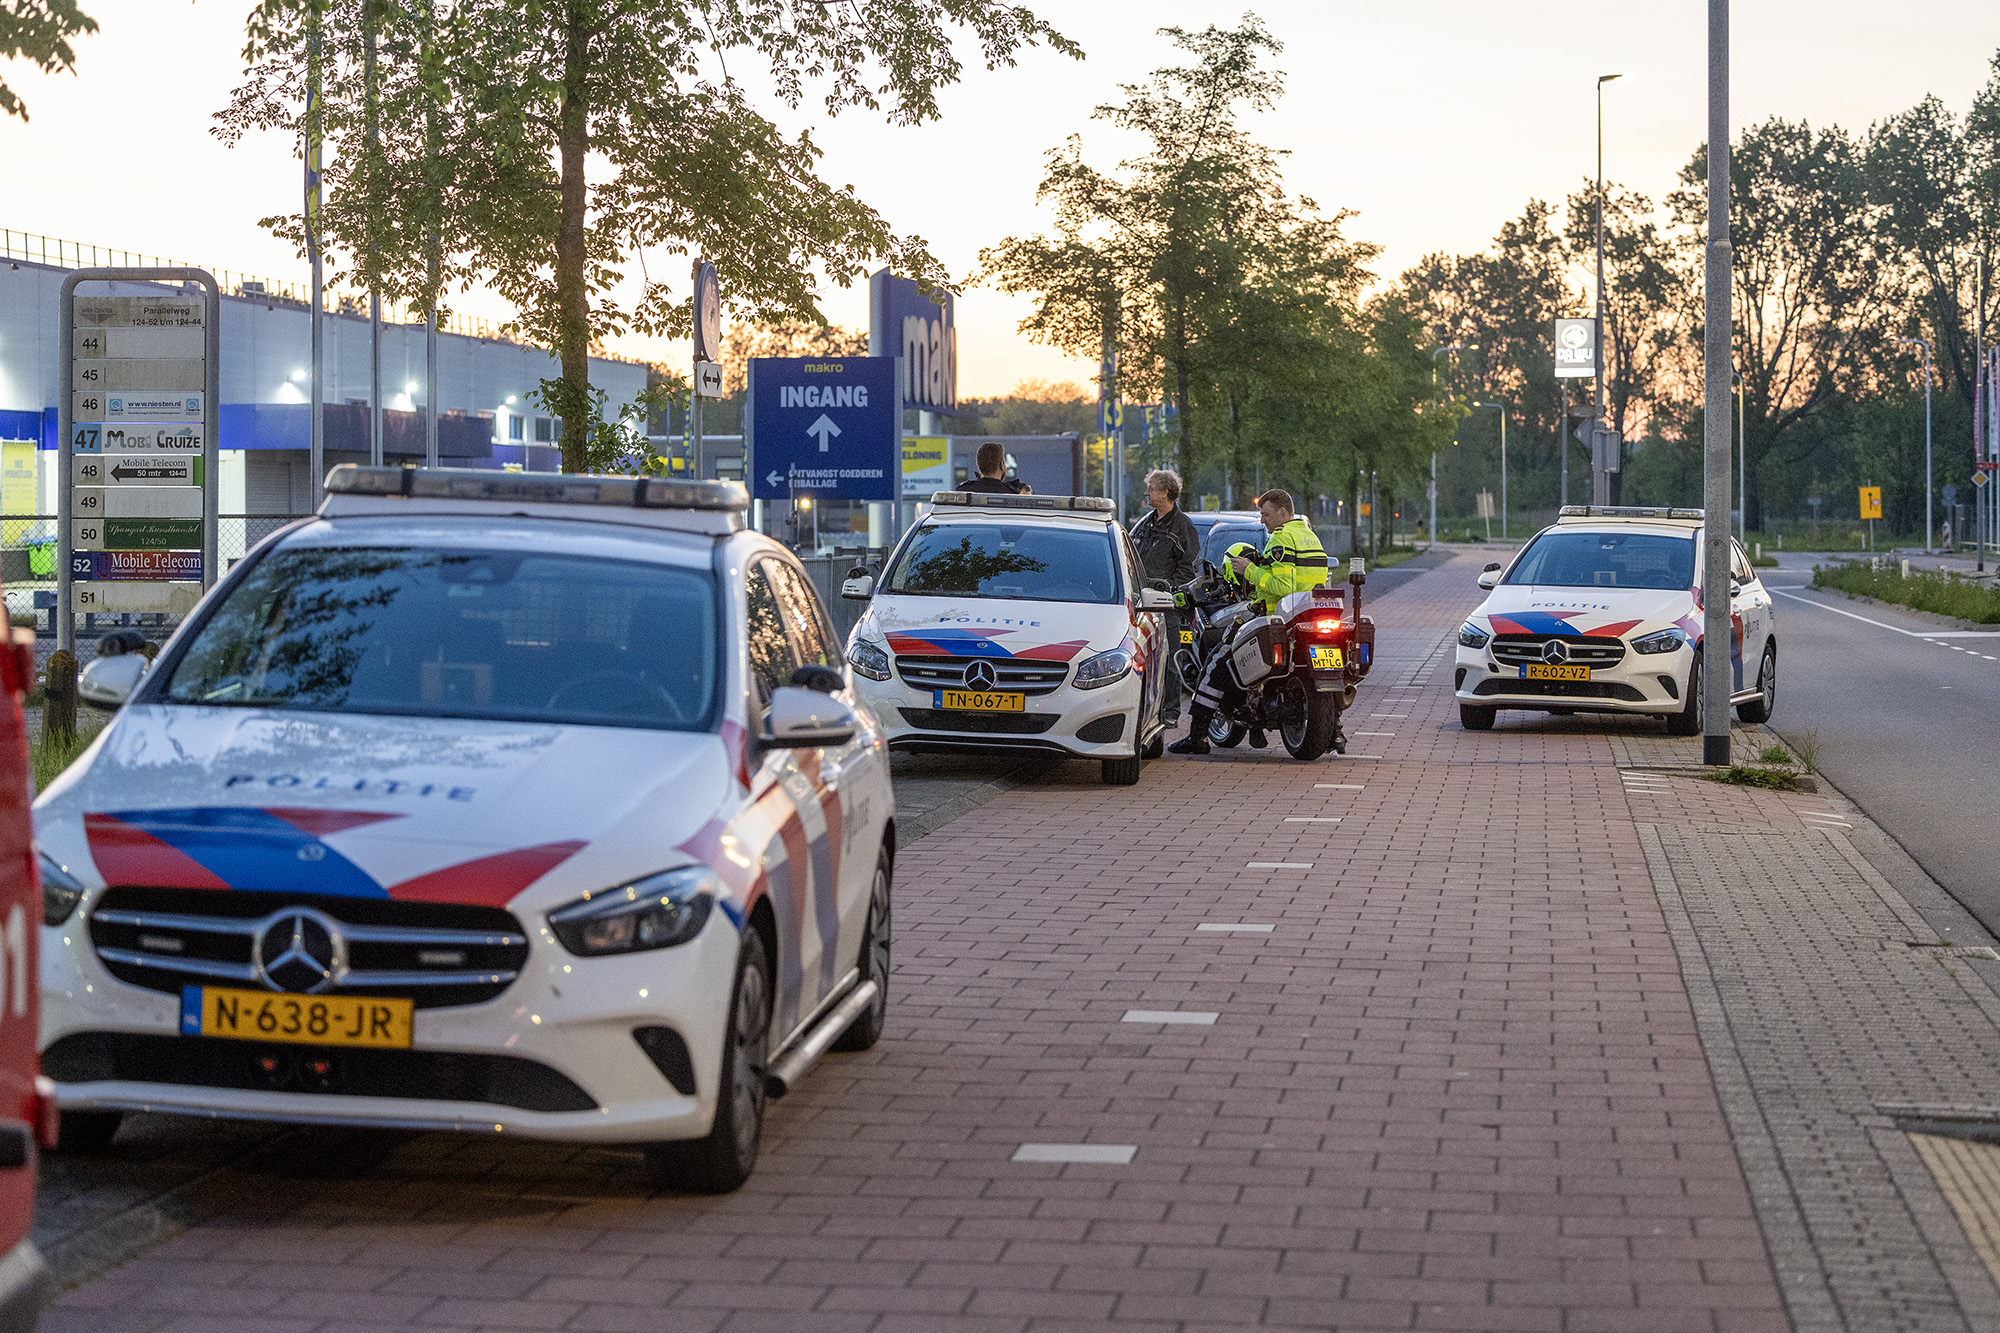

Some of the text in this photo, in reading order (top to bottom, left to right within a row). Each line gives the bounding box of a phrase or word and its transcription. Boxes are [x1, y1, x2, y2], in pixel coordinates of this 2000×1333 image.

[143, 307, 190, 316] Parallelweg
[132, 318, 202, 326] 124-52 t/m 124-44
[82, 338, 99, 349] 44
[804, 362, 844, 373] makro
[82, 370, 98, 381] 45
[780, 386, 868, 408] INGANG
[82, 399, 98, 410] 46
[75, 430, 99, 448] 47
[157, 430, 200, 448] CRUIZE
[122, 459, 186, 467] Mobile Telecom
[81, 465, 98, 476] 48
[137, 469, 186, 477] 50 mtr 124-48
[839, 469, 883, 478] GOEDEREN
[81, 496, 97, 508] 49
[81, 528, 97, 540] 50
[73, 559, 92, 573] 52
[112, 553, 202, 568] Mobile Telecom
[80, 592, 95, 603] 51
[1531, 602, 1611, 611] POLITIE
[939, 617, 1041, 628] POLITIE
[1324, 649, 1334, 658] 18
[1530, 666, 1587, 679] R-602-VZ
[947, 692, 1018, 709] TN-067-T
[224, 773, 478, 802] POLITIE
[216, 996, 391, 1039] N-638-JR
